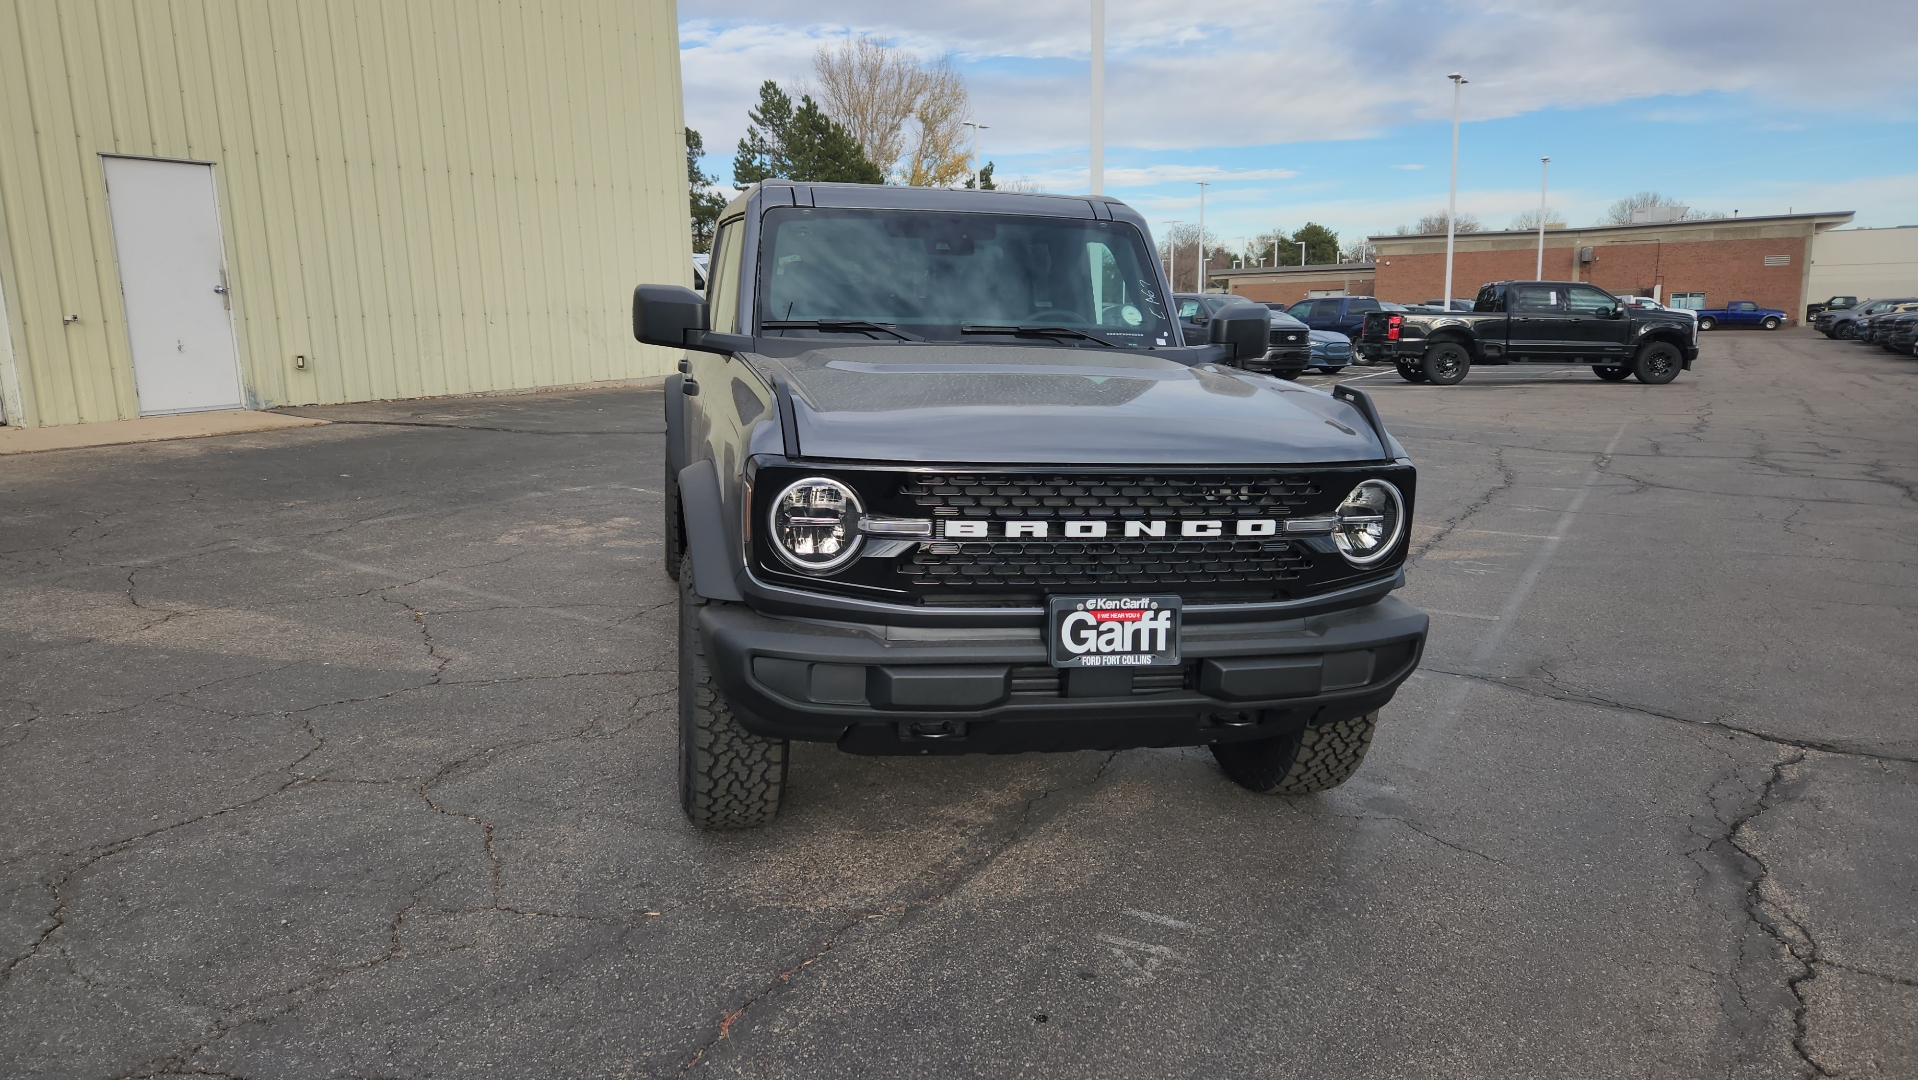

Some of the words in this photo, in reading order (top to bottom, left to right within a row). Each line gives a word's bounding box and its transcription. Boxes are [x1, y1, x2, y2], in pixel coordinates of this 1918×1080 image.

[944, 519, 1277, 538] BRONCO
[1097, 598, 1120, 609] Ken
[1120, 598, 1150, 609] Garff
[1061, 610, 1171, 654] Garff
[1081, 655, 1100, 666] FORD
[1102, 655, 1120, 665] FORT
[1122, 655, 1152, 665] COLLINS
